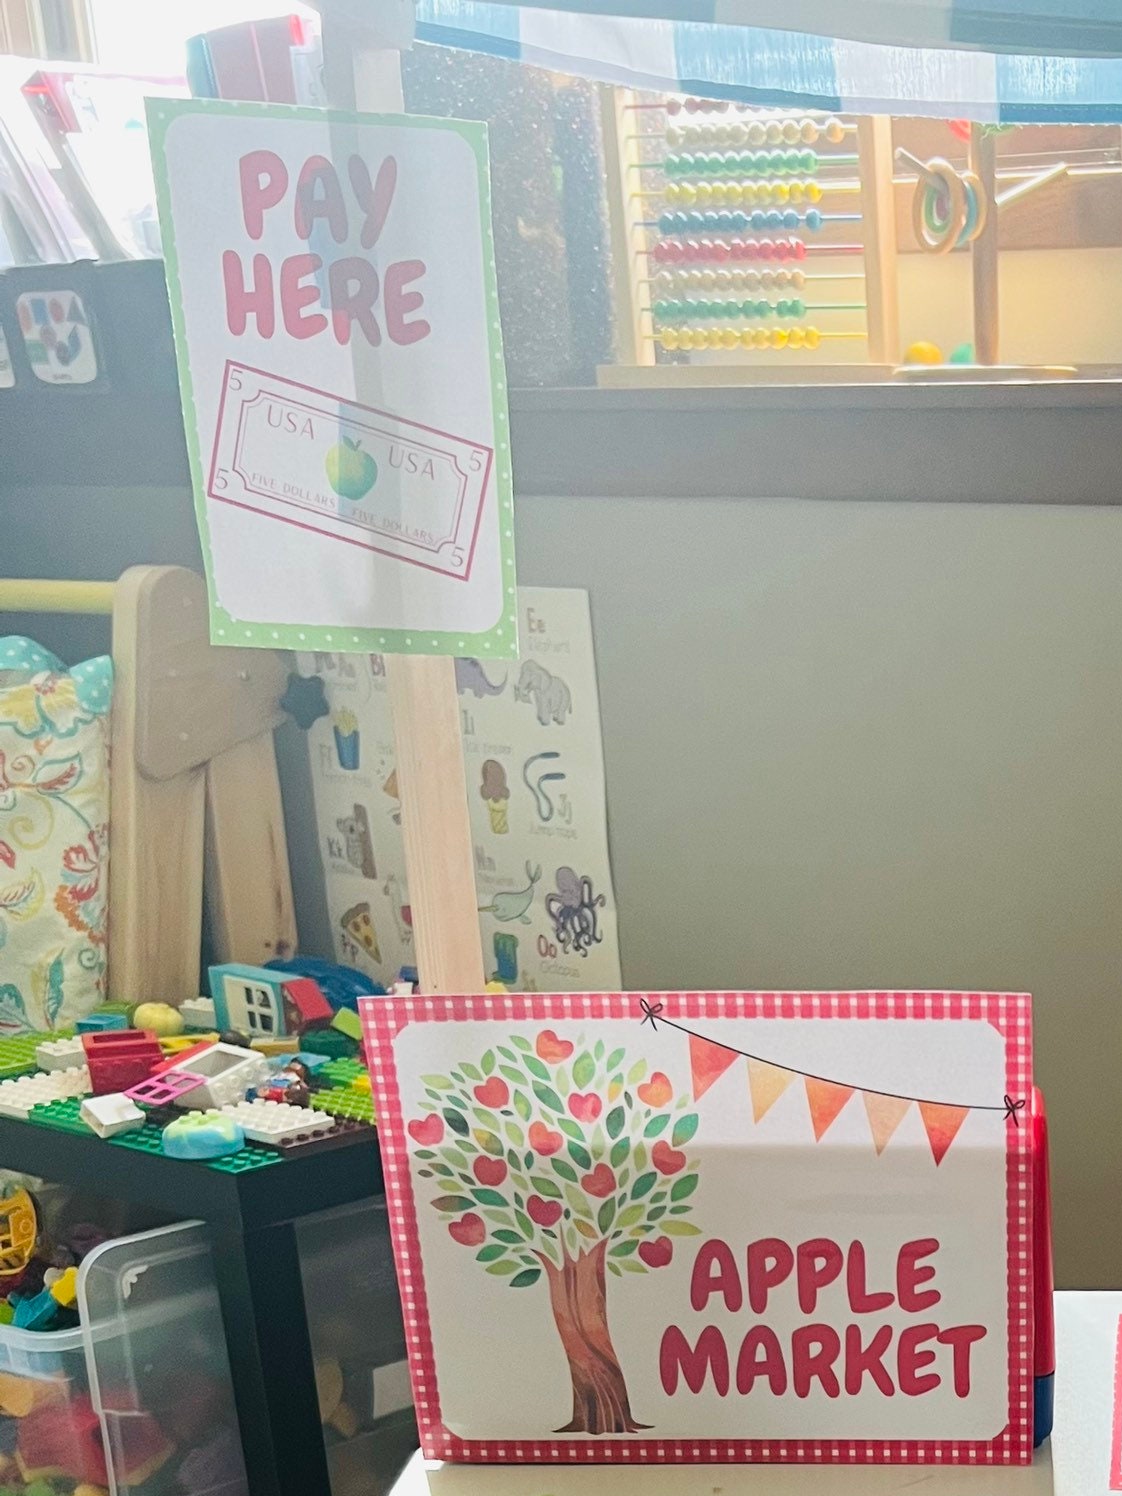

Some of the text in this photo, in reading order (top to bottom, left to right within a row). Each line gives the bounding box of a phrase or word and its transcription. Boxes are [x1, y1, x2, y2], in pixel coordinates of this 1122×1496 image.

[239, 150, 397, 249] PAY
[222, 250, 431, 346] HERE
[229, 369, 243, 391] 5
[267, 405, 315, 440] USA
[388, 446, 435, 480] USA
[469, 450, 483, 472] 5
[215, 469, 229, 490] 5
[252, 472, 336, 508] FIVE DOLLARS
[352, 509, 434, 543] FIVE DOLLARS
[450, 546, 465, 567] 5
[690, 1237, 942, 1314] APPLE
[659, 1322, 987, 1399] MARKET
